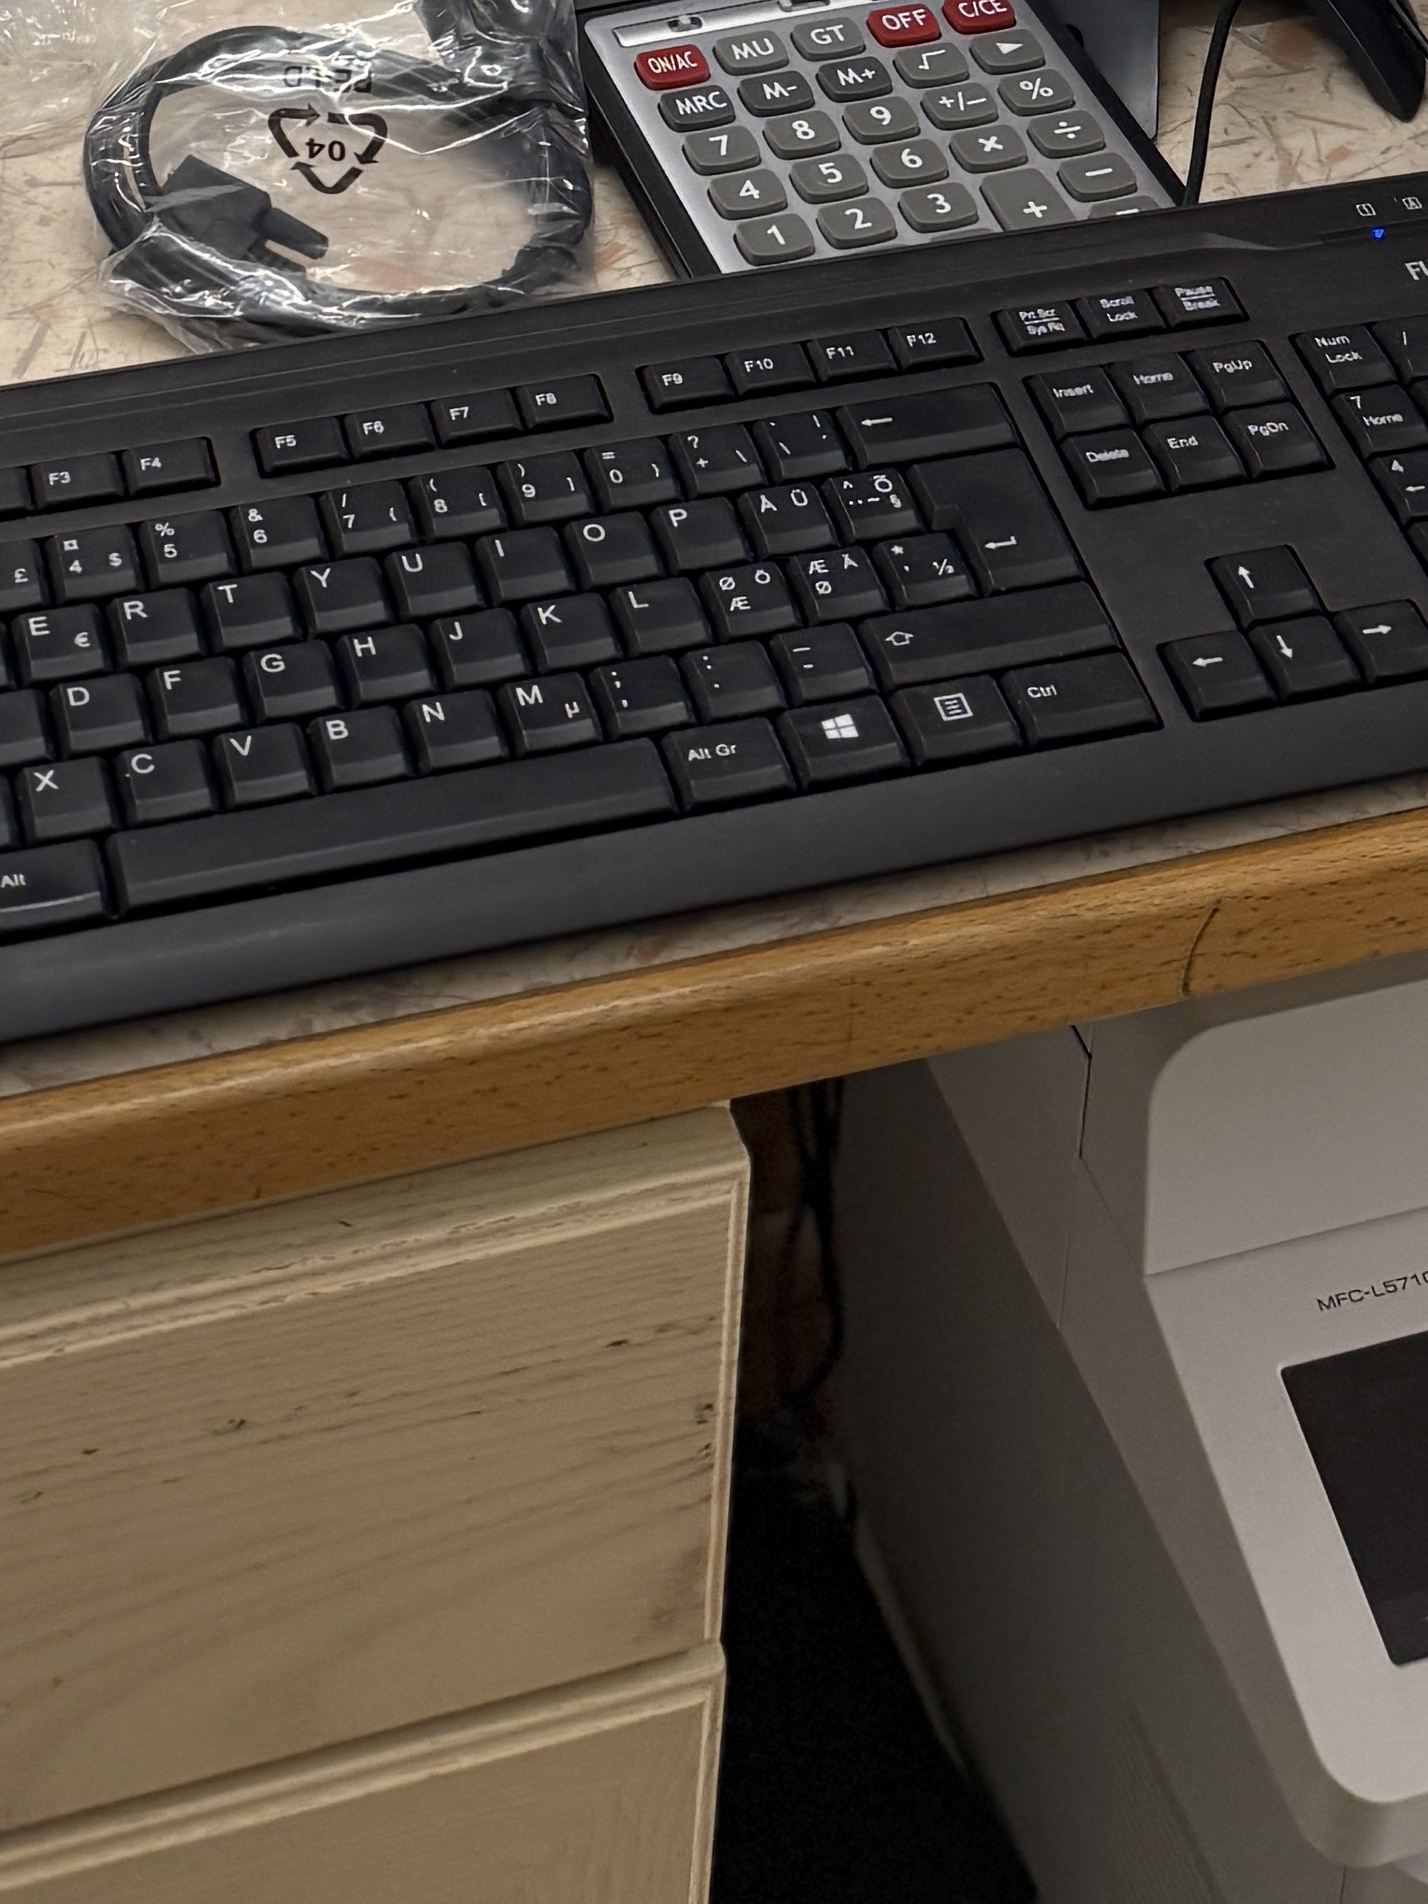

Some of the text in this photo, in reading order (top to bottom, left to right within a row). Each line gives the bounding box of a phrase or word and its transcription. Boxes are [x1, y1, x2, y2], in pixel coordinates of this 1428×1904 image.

[647, 51, 698, 76] ON/AC
[731, 36, 774, 61] MU
[810, 23, 846, 47] GT
[881, 9, 927, 34] OFF
[675, 65, 877, 117] MRC M- M+
[710, 106, 891, 157] 7 8 9
[1315, 334, 1351, 348] Num
[1325, 350, 1363, 364] Lock
[1052, 358, 1253, 398] Insert PgUp
[1167, 435, 1199, 450] End
[48, 470, 71, 486] F3
[0, 871, 27, 889] Alt
[686, 746, 713, 763] Alt
[714, 740, 738, 758] Gr
